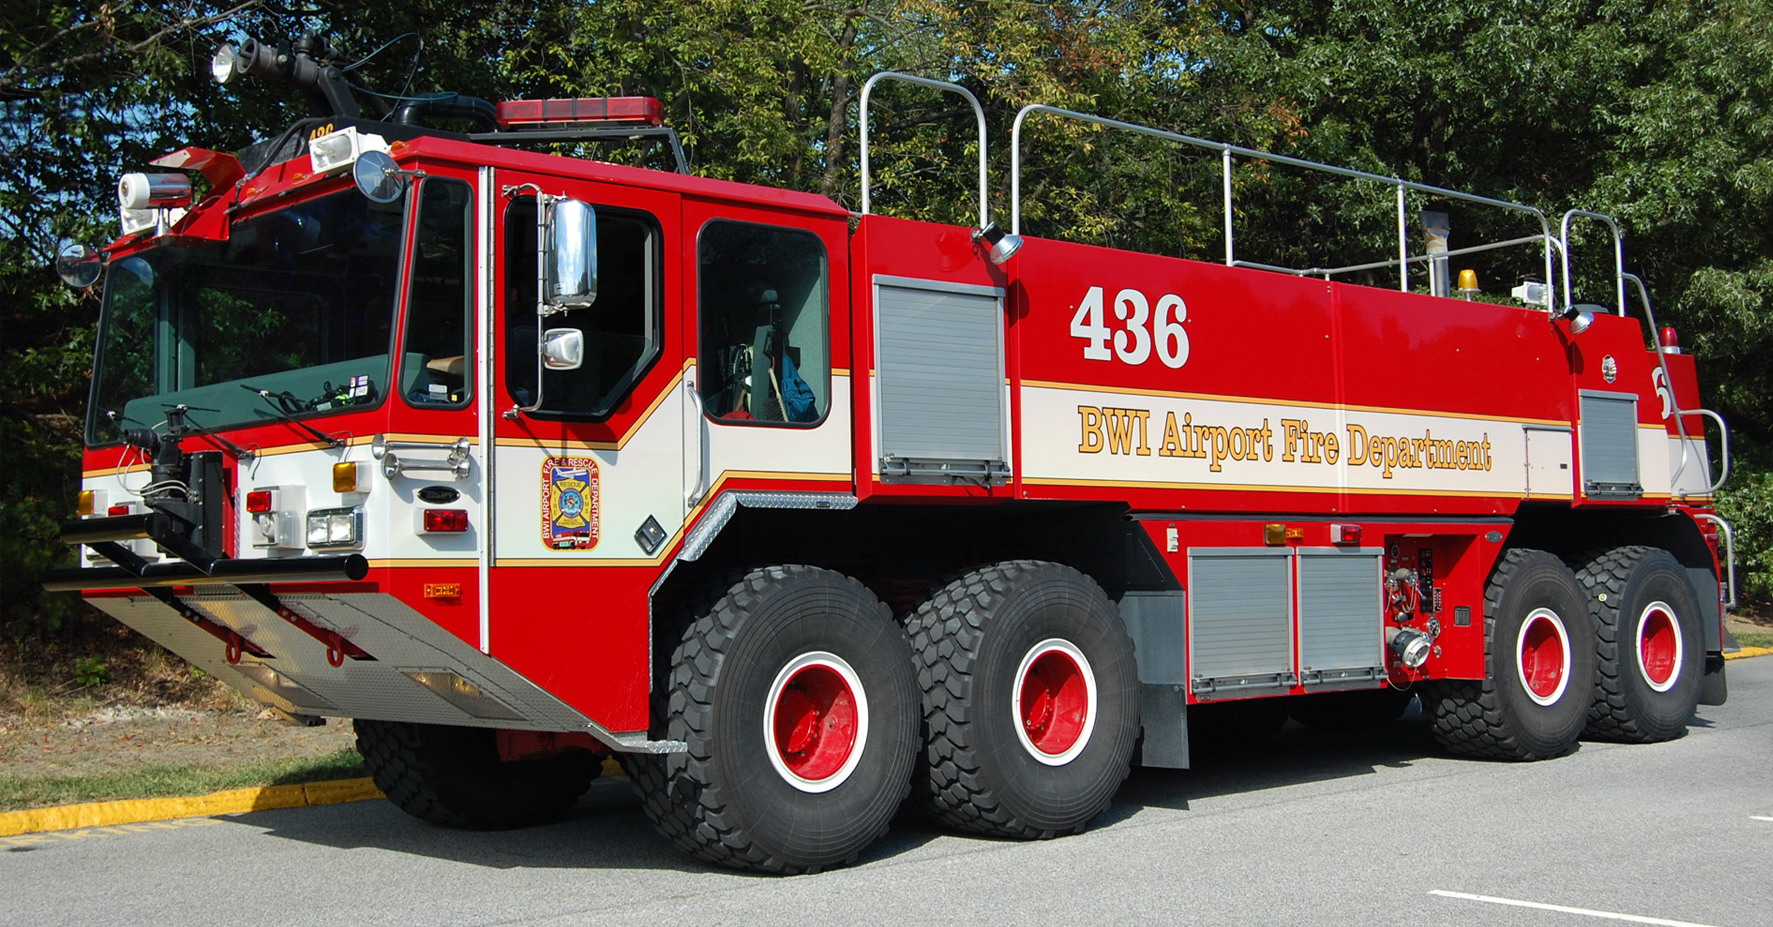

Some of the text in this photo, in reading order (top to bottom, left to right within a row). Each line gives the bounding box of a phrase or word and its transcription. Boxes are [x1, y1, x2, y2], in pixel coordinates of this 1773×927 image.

[1070, 285, 1190, 369] 436
[1078, 405, 1492, 479] BWI Airport Fire Department
[543, 458, 560, 474] FIRE
[568, 458, 598, 474] RESCUE
[542, 479, 550, 520] AIRPORT
[542, 521, 550, 539] BWI
